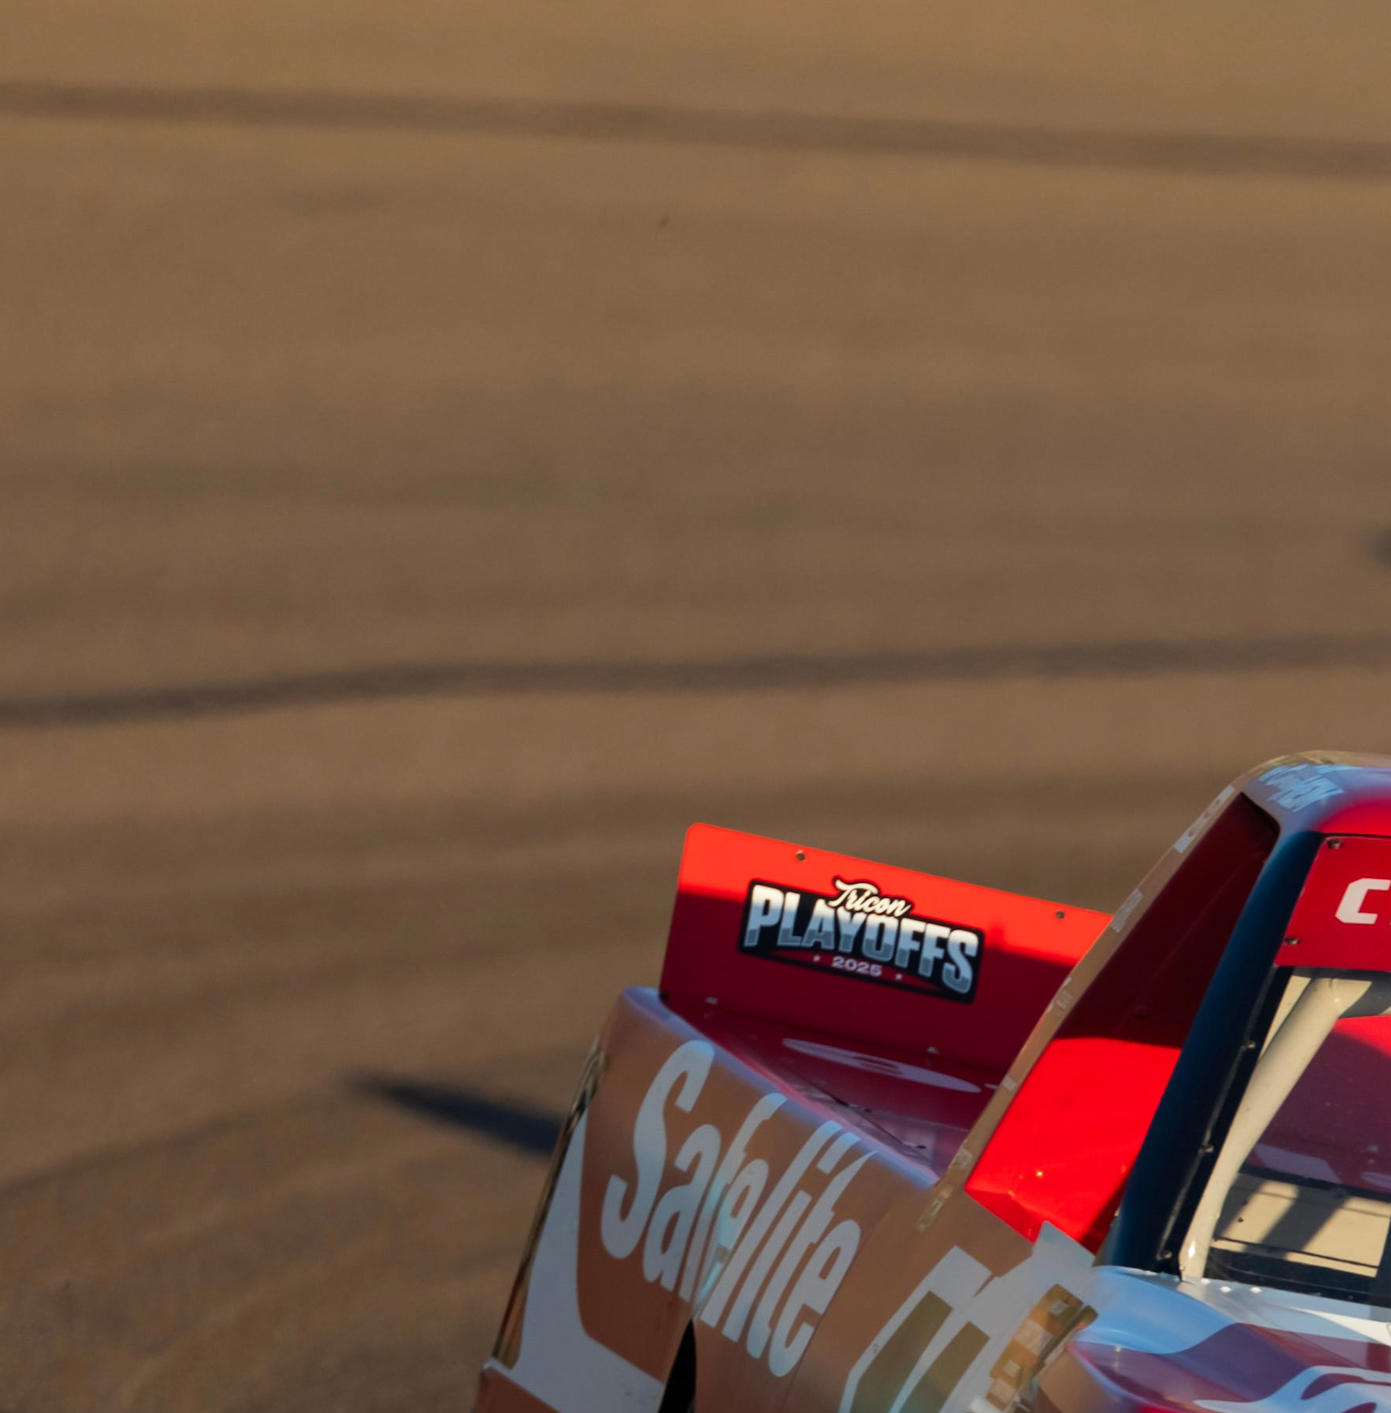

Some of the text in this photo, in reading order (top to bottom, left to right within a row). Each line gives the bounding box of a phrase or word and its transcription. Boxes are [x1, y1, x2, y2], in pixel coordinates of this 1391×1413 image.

[743, 883, 980, 995] PLAYOFFS
[831, 955, 883, 978] 2025
[600, 1039, 879, 1378] Safelite
